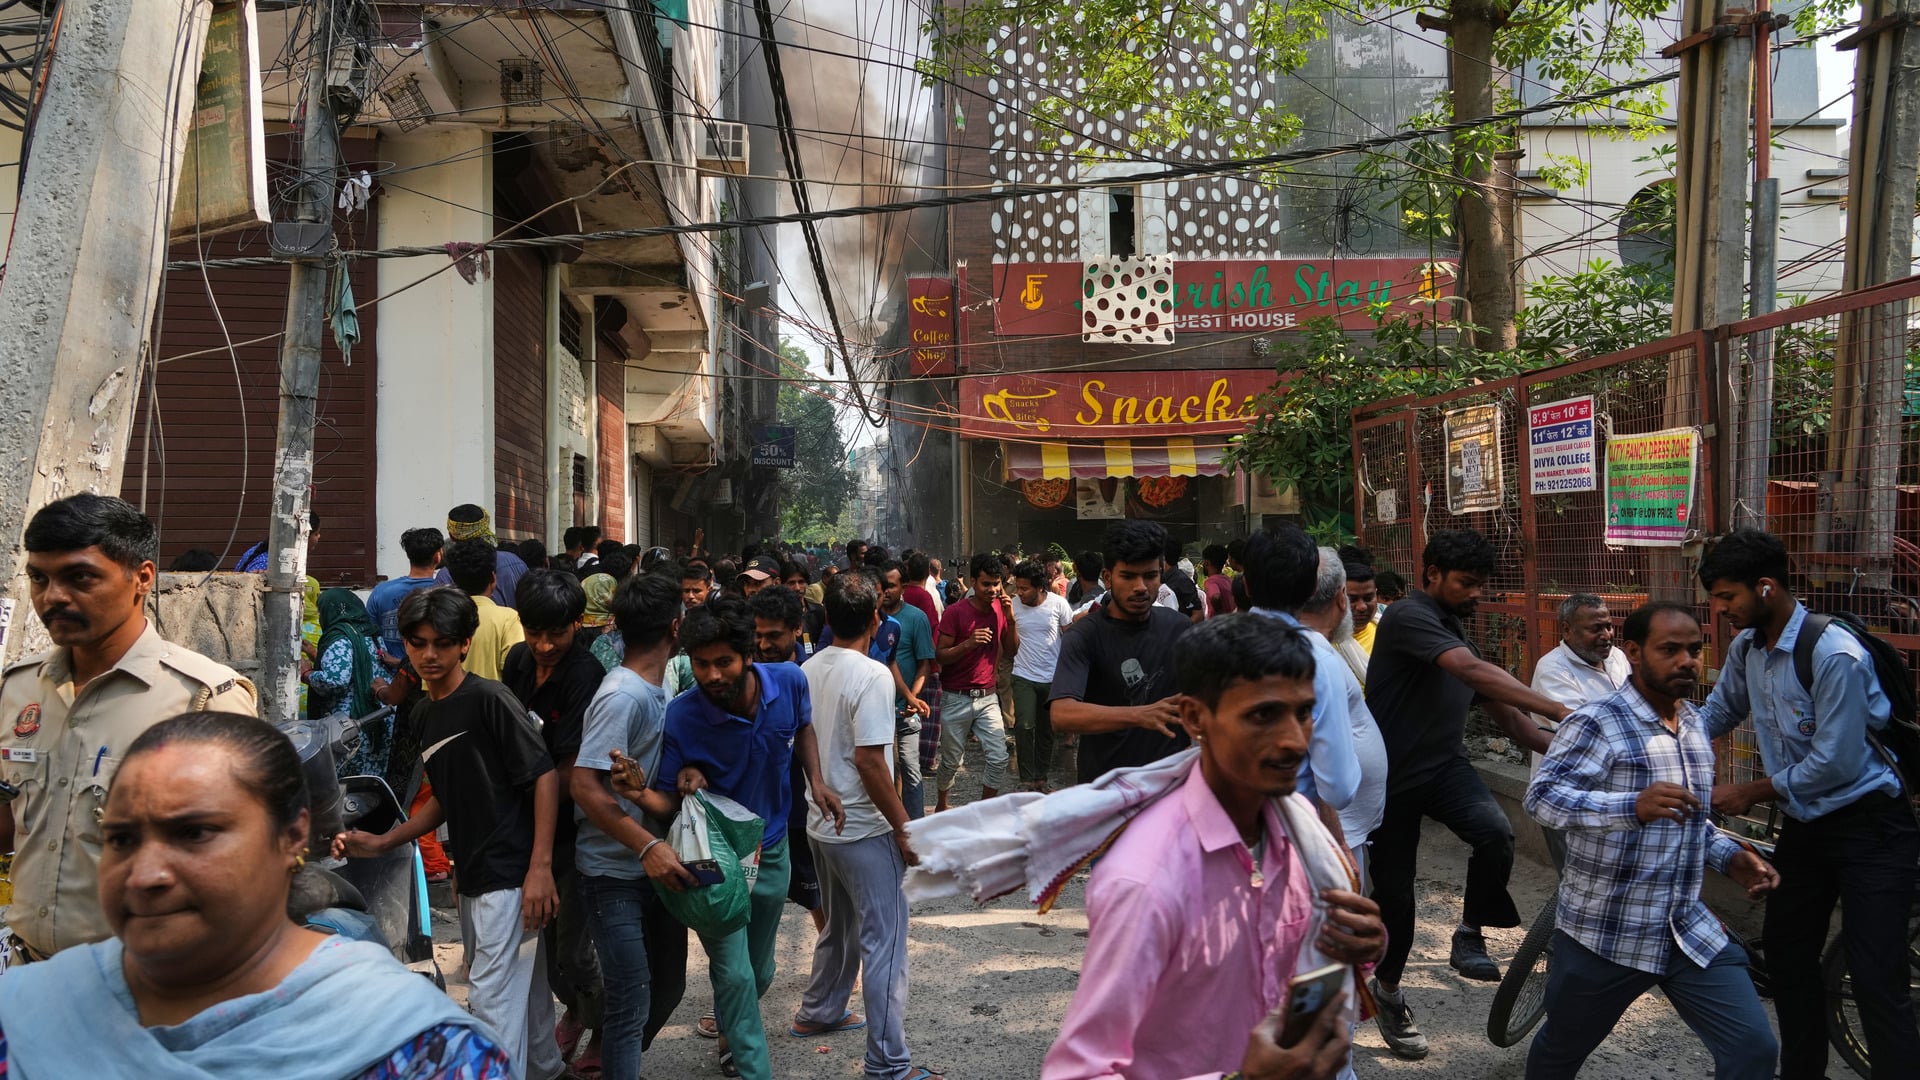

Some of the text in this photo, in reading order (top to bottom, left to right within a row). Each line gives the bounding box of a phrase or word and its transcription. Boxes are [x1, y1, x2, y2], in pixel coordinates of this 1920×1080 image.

[1230, 312, 1296, 328] HOUSE
[913, 328, 950, 344] Coffee
[1009, 400, 1039, 408] Snacks
[760, 444, 787, 456] 50%
[1574, 441, 1591, 449] CLASSES
[1625, 442, 1648, 461] FANCY
[1649, 440, 1670, 459] DRESS
[1671, 438, 1690, 458] ZONE
[1534, 452, 1591, 469] DIVYA COLLEGE
[1535, 471, 1546, 479] MAIN
[1566, 467, 1590, 475] MUNIRKA
[1535, 477, 1592, 491] PH: 9212252068
[1644, 508, 1656, 518] LOW
[1657, 508, 1673, 518] PRICE
